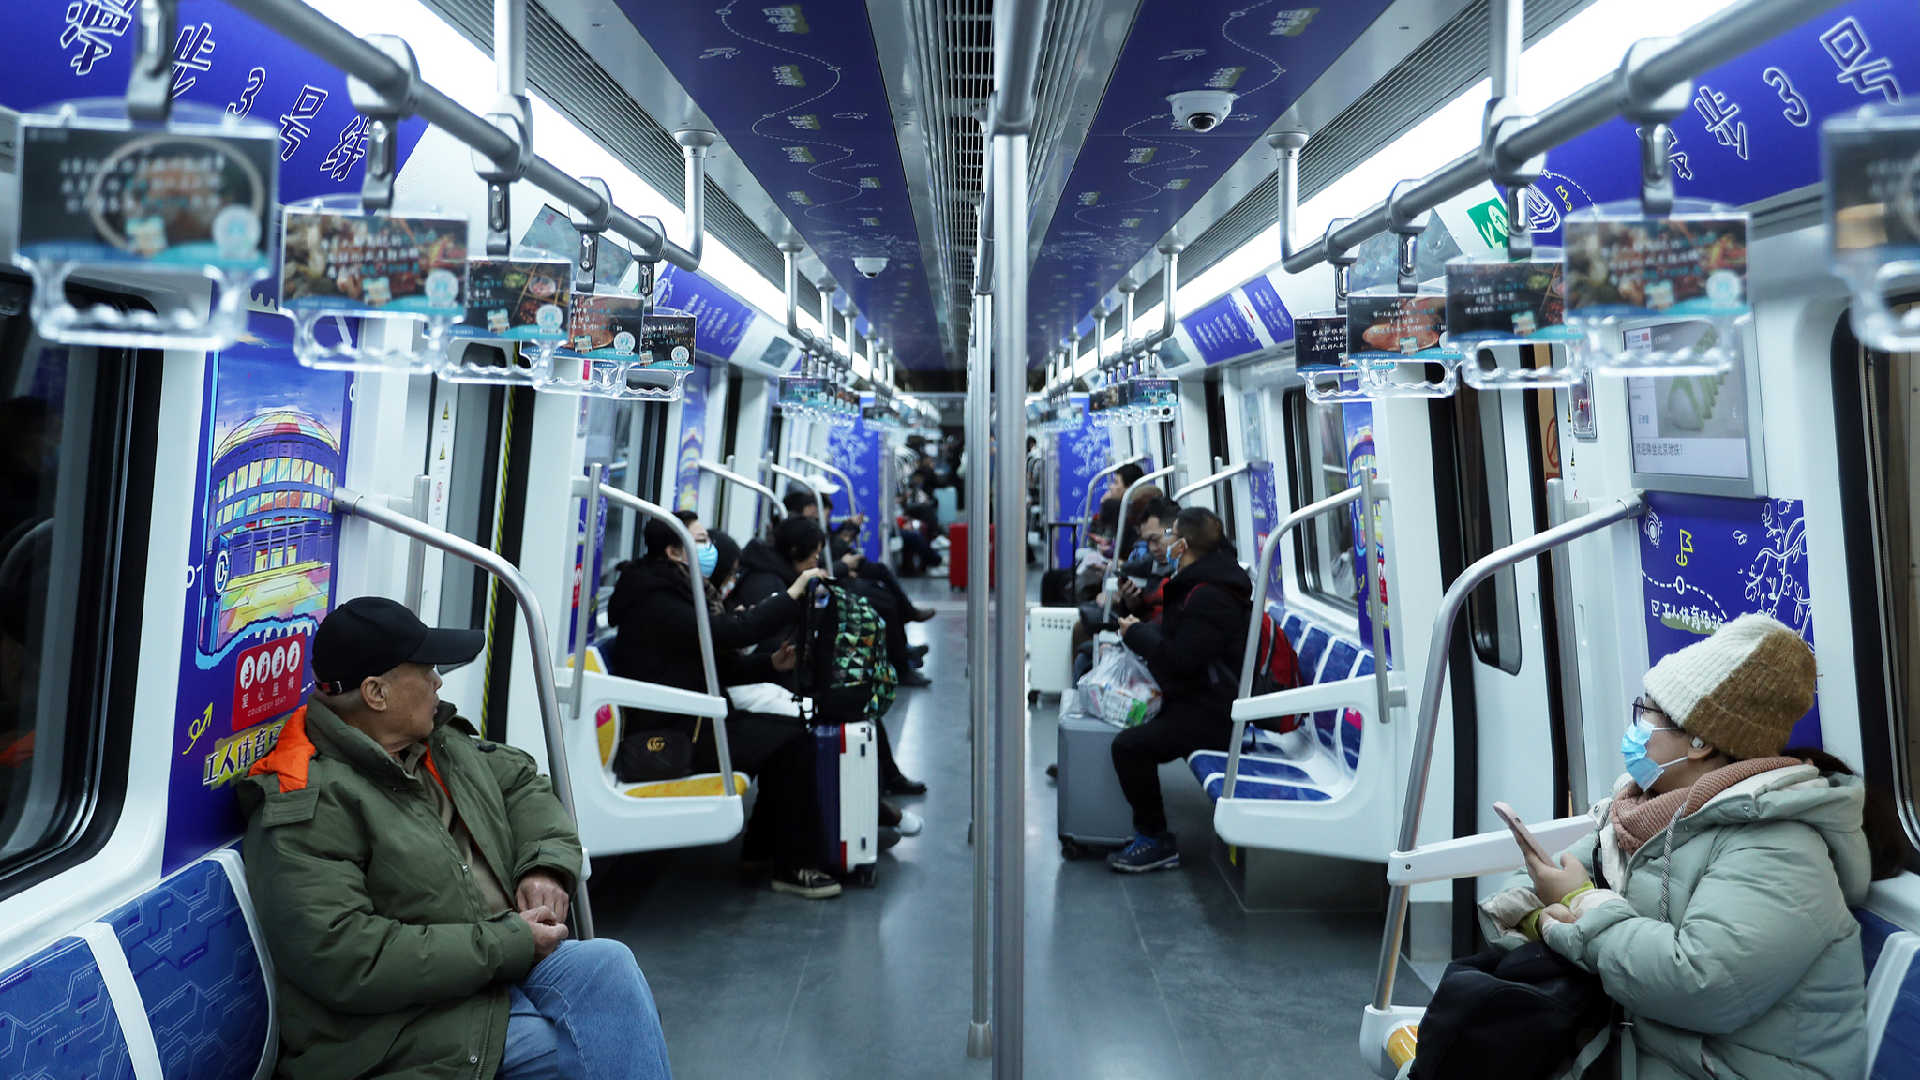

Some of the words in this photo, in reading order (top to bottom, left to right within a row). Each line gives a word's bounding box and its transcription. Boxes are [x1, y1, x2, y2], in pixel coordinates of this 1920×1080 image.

[241, 676, 295, 709] 爱心座椅
[247, 702, 275, 717] COURTESY
